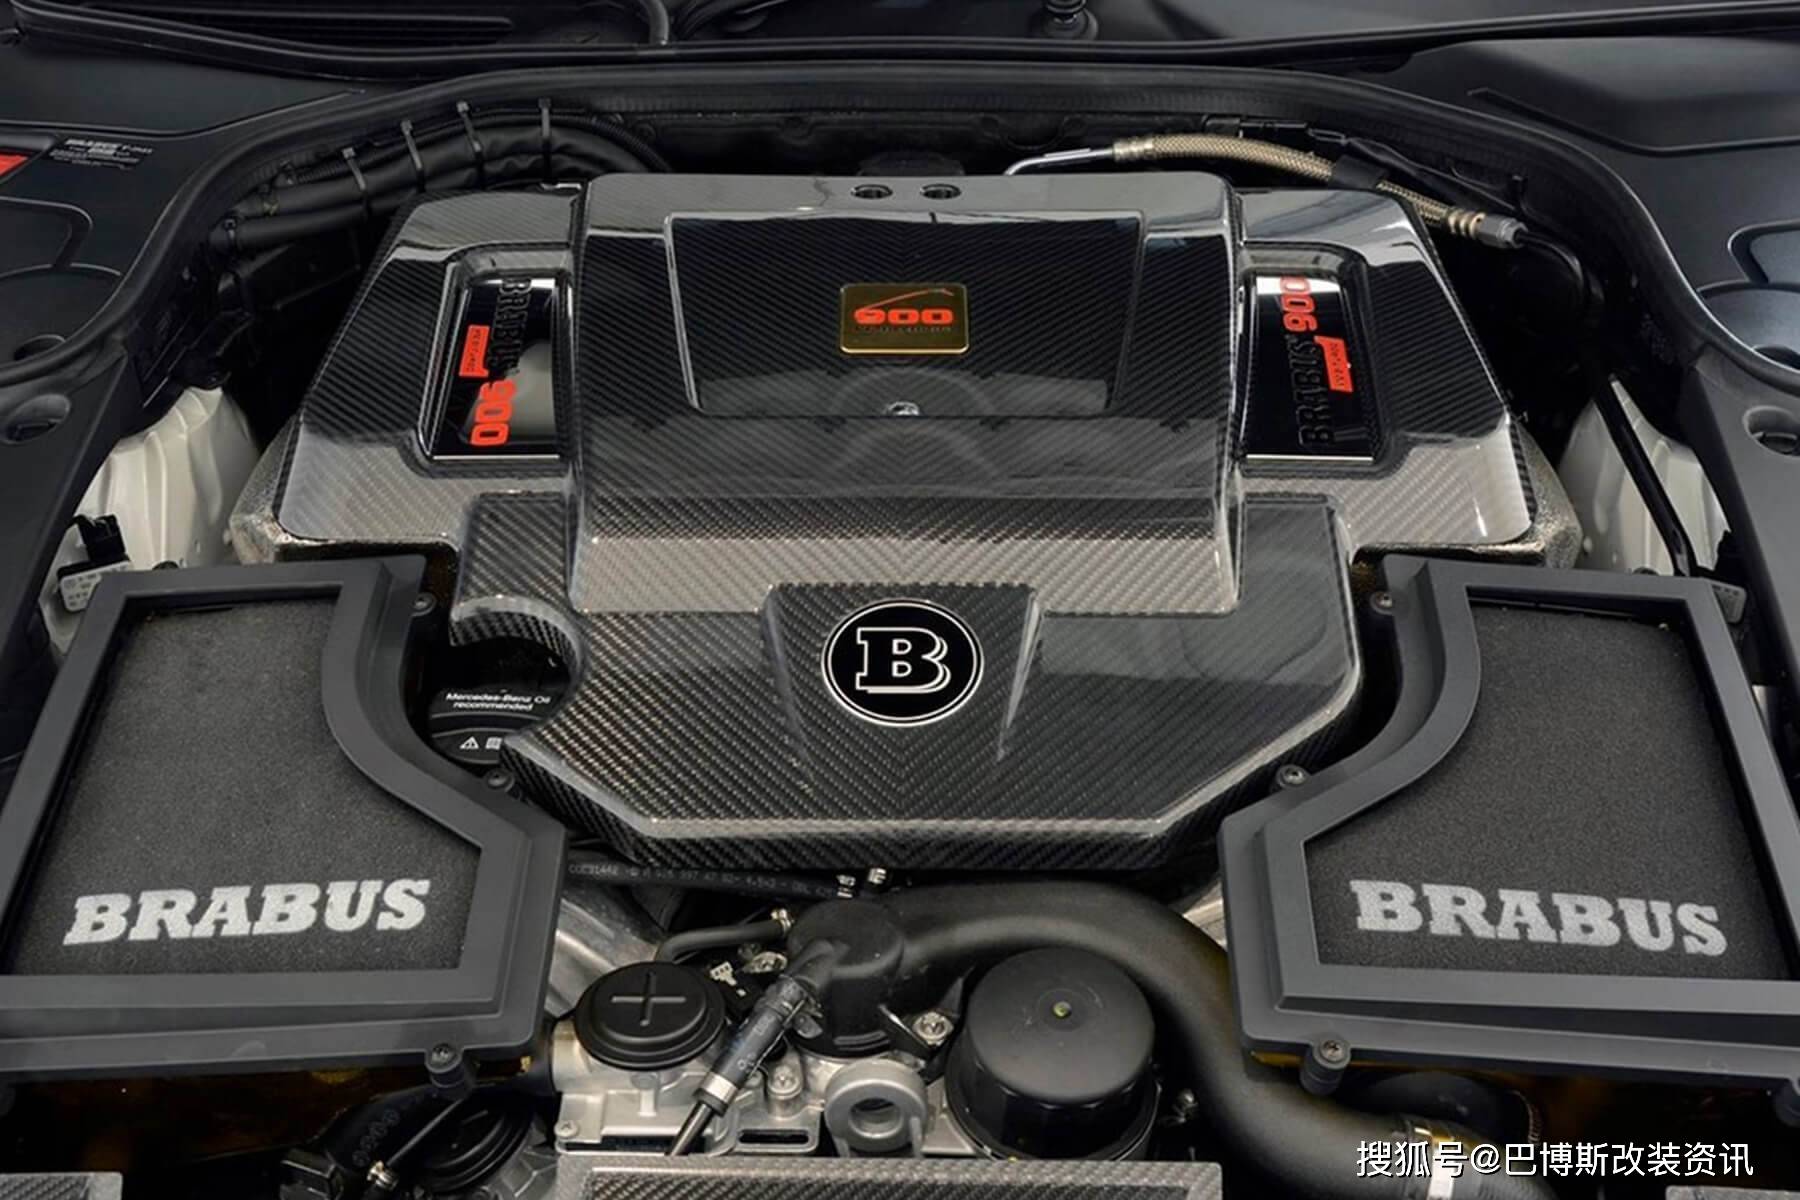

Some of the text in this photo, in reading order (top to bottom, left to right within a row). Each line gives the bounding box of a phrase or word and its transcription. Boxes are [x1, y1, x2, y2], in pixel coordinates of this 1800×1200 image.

[1279, 276, 1333, 446] BRABUS 900
[470, 379, 516, 446] 900
[856, 627, 951, 694] B
[453, 702, 534, 712] recommended
[62, 878, 431, 946] BRABUS
[1349, 879, 1728, 957] BRABUS
